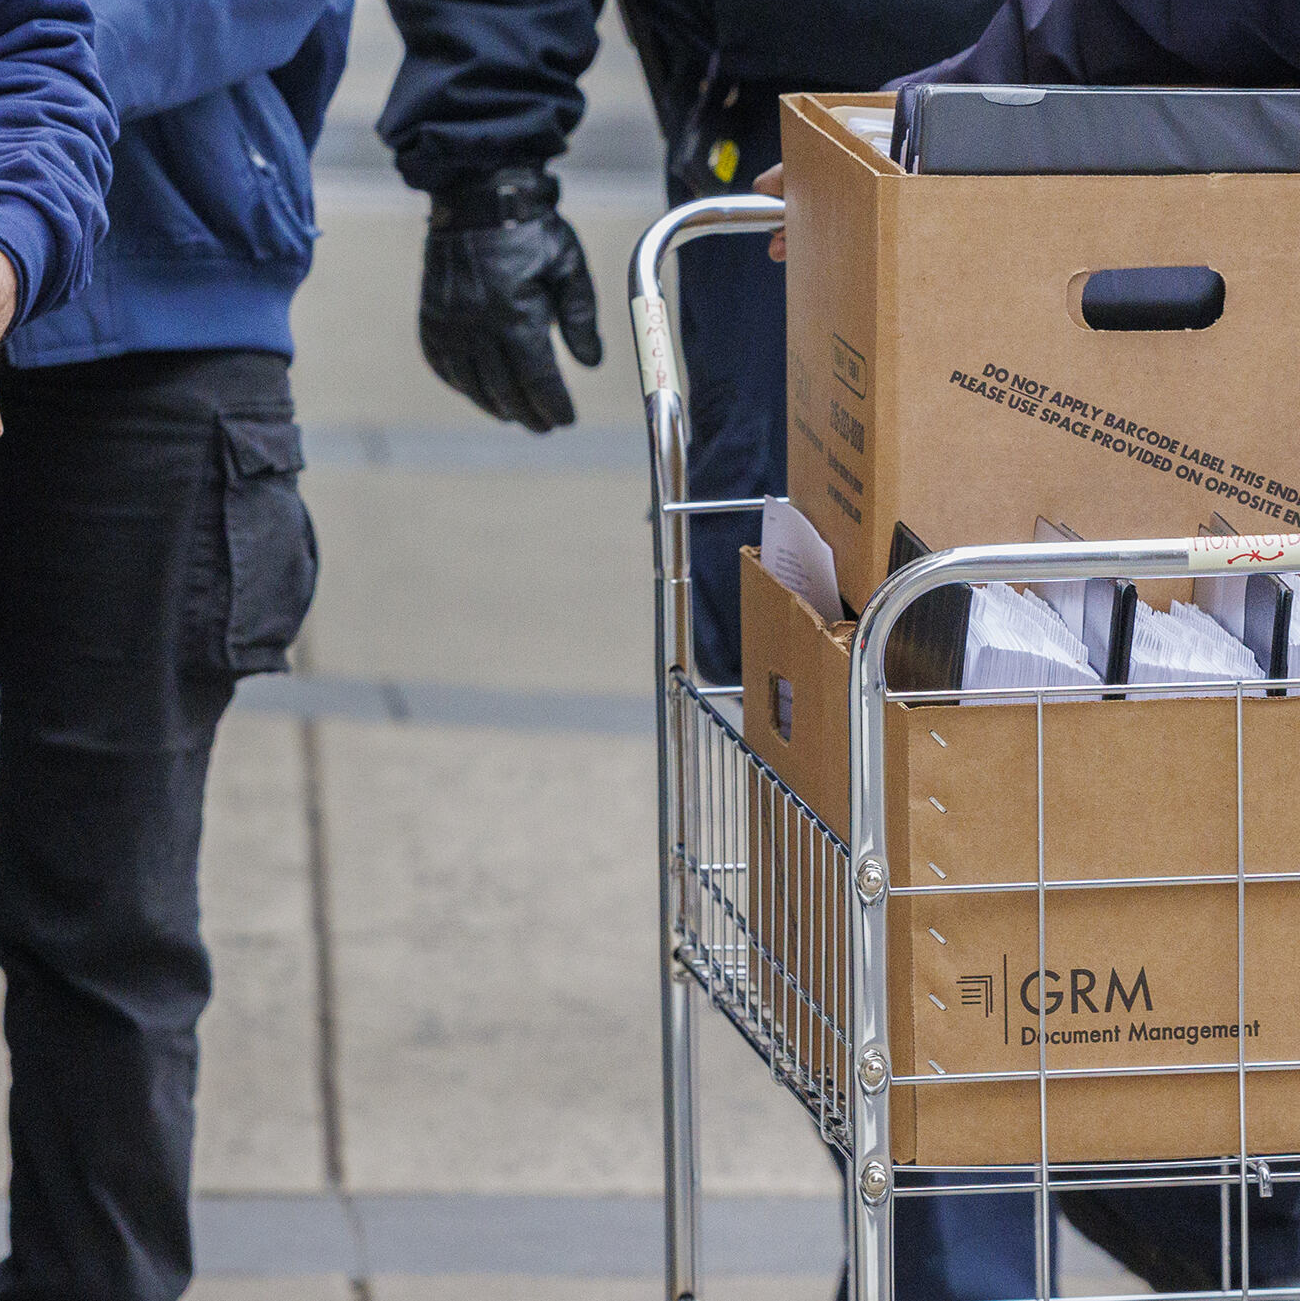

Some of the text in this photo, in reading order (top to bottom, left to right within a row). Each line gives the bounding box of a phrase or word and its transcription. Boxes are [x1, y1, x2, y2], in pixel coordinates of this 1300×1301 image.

[949, 370, 1007, 404] PLEASE
[1007, 393, 1039, 418] USE
[1039, 407, 1092, 439] SPACE
[1090, 428, 1173, 473] PROVIDED
[1175, 464, 1204, 487] ON
[1205, 477, 1283, 519] OPPOSITE
[982, 363, 1009, 384] DO
[1009, 374, 1050, 402] NOT
[1049, 391, 1104, 422] APPLY
[1103, 412, 1180, 455] BARCODE
[1180, 444, 1225, 475] LABEL
[1229, 463, 1266, 490] THIS
[1019, 966, 1154, 1017] GRM
[1020, 1019, 1261, 1047] Document Management
